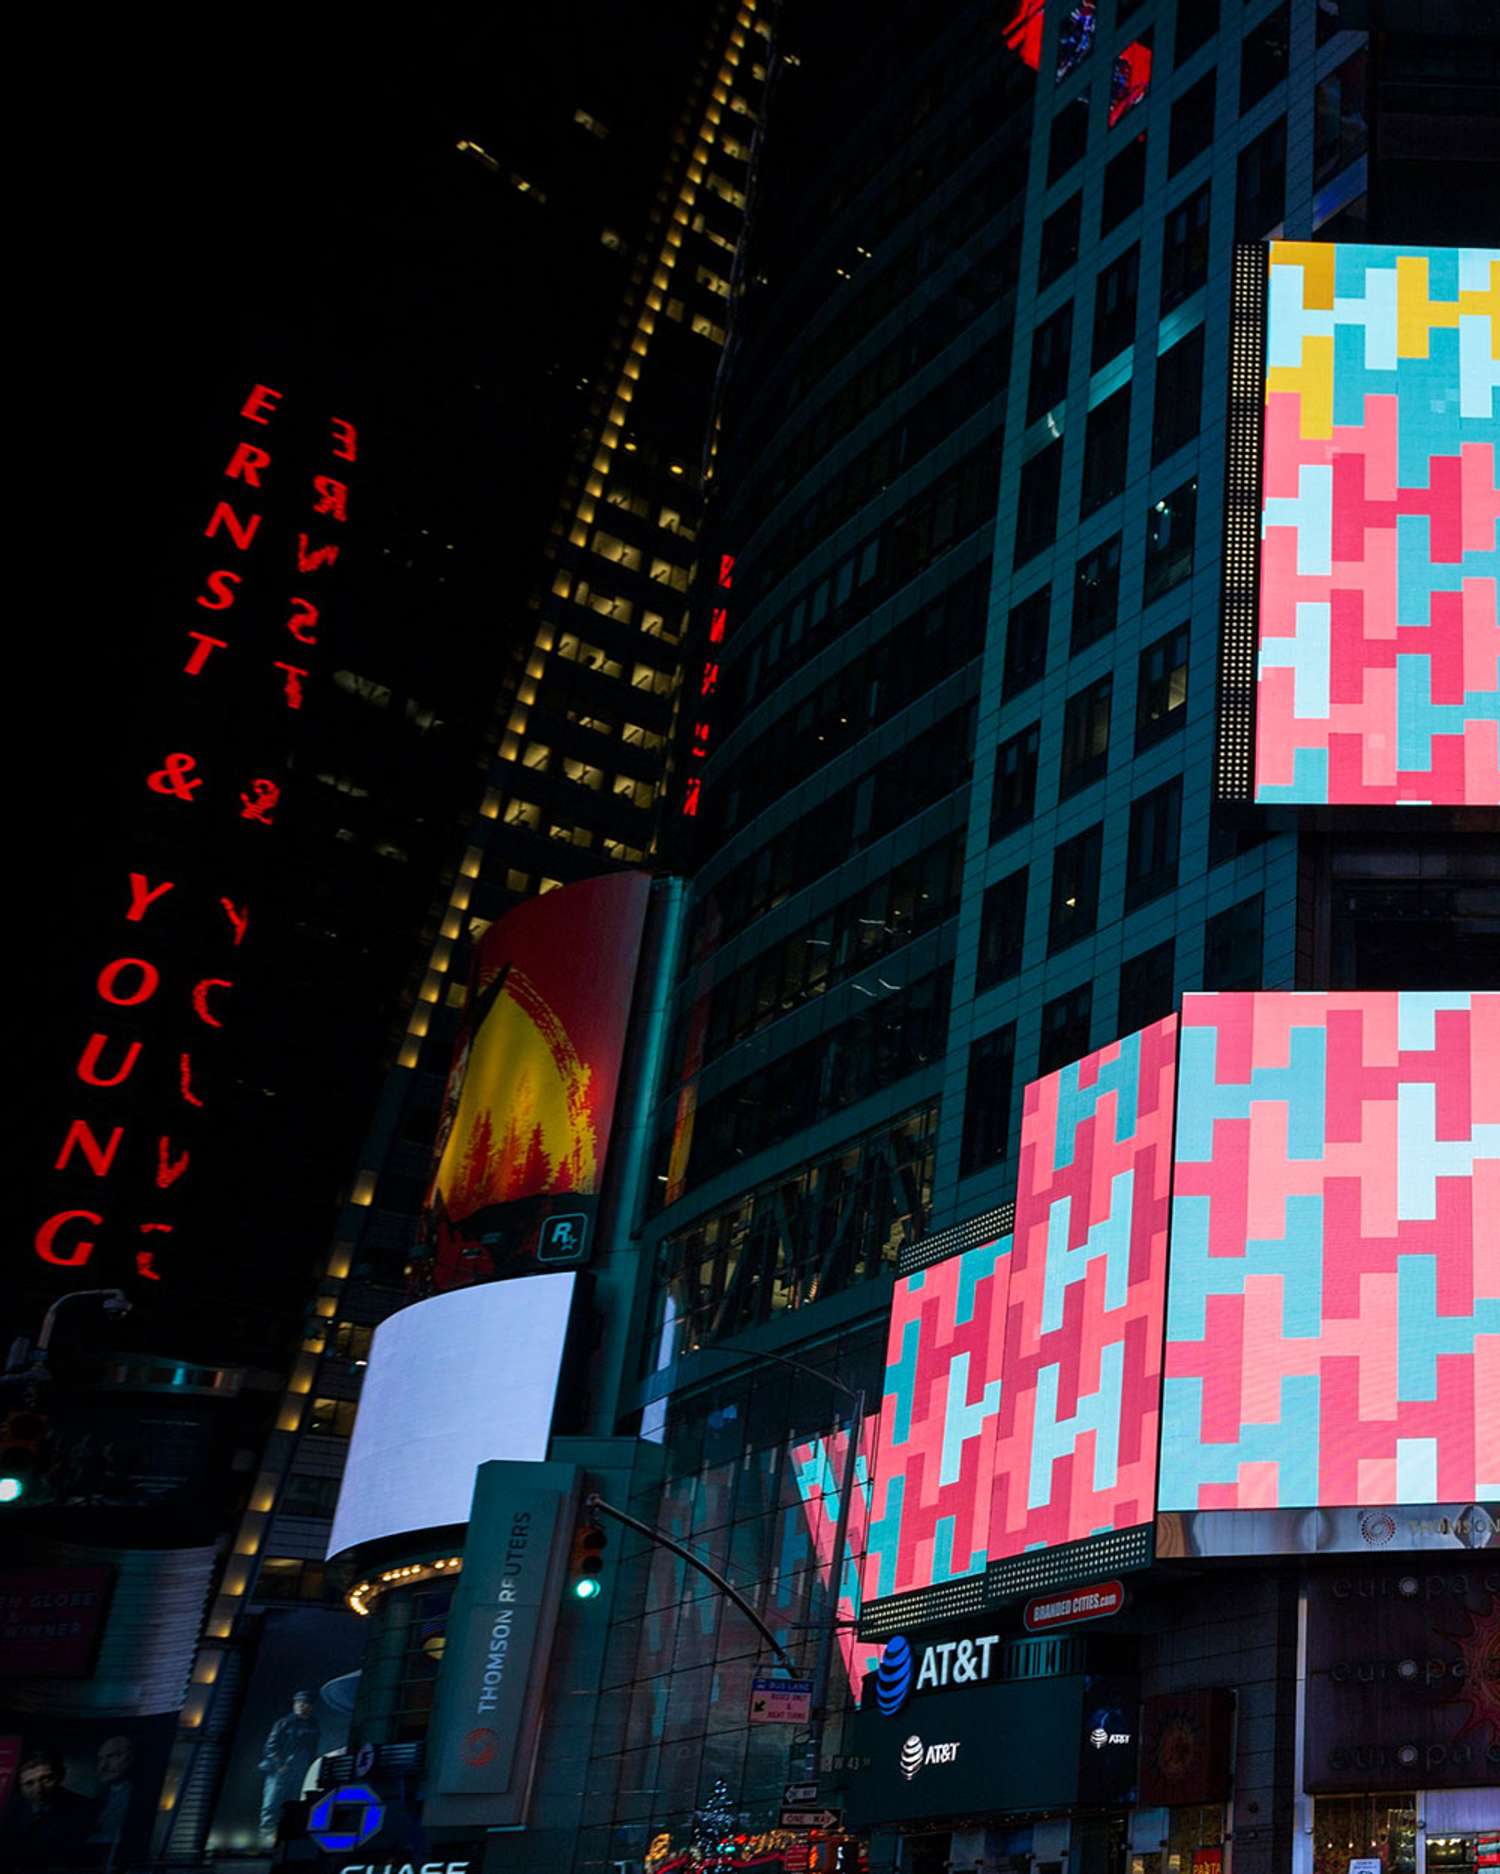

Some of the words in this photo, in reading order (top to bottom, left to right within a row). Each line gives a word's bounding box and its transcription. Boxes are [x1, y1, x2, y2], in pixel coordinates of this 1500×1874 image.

[184, 384, 282, 676] ERNST
[146, 752, 203, 800] &
[34, 873, 173, 1267] YOUNG
[478, 1610, 513, 1714] THOMSON
[499, 1511, 531, 1602] REUTERS
[915, 1634, 1000, 1691] AT&T
[923, 1741, 961, 1766] AT&T
[1107, 1733, 1133, 1745] AT&T
